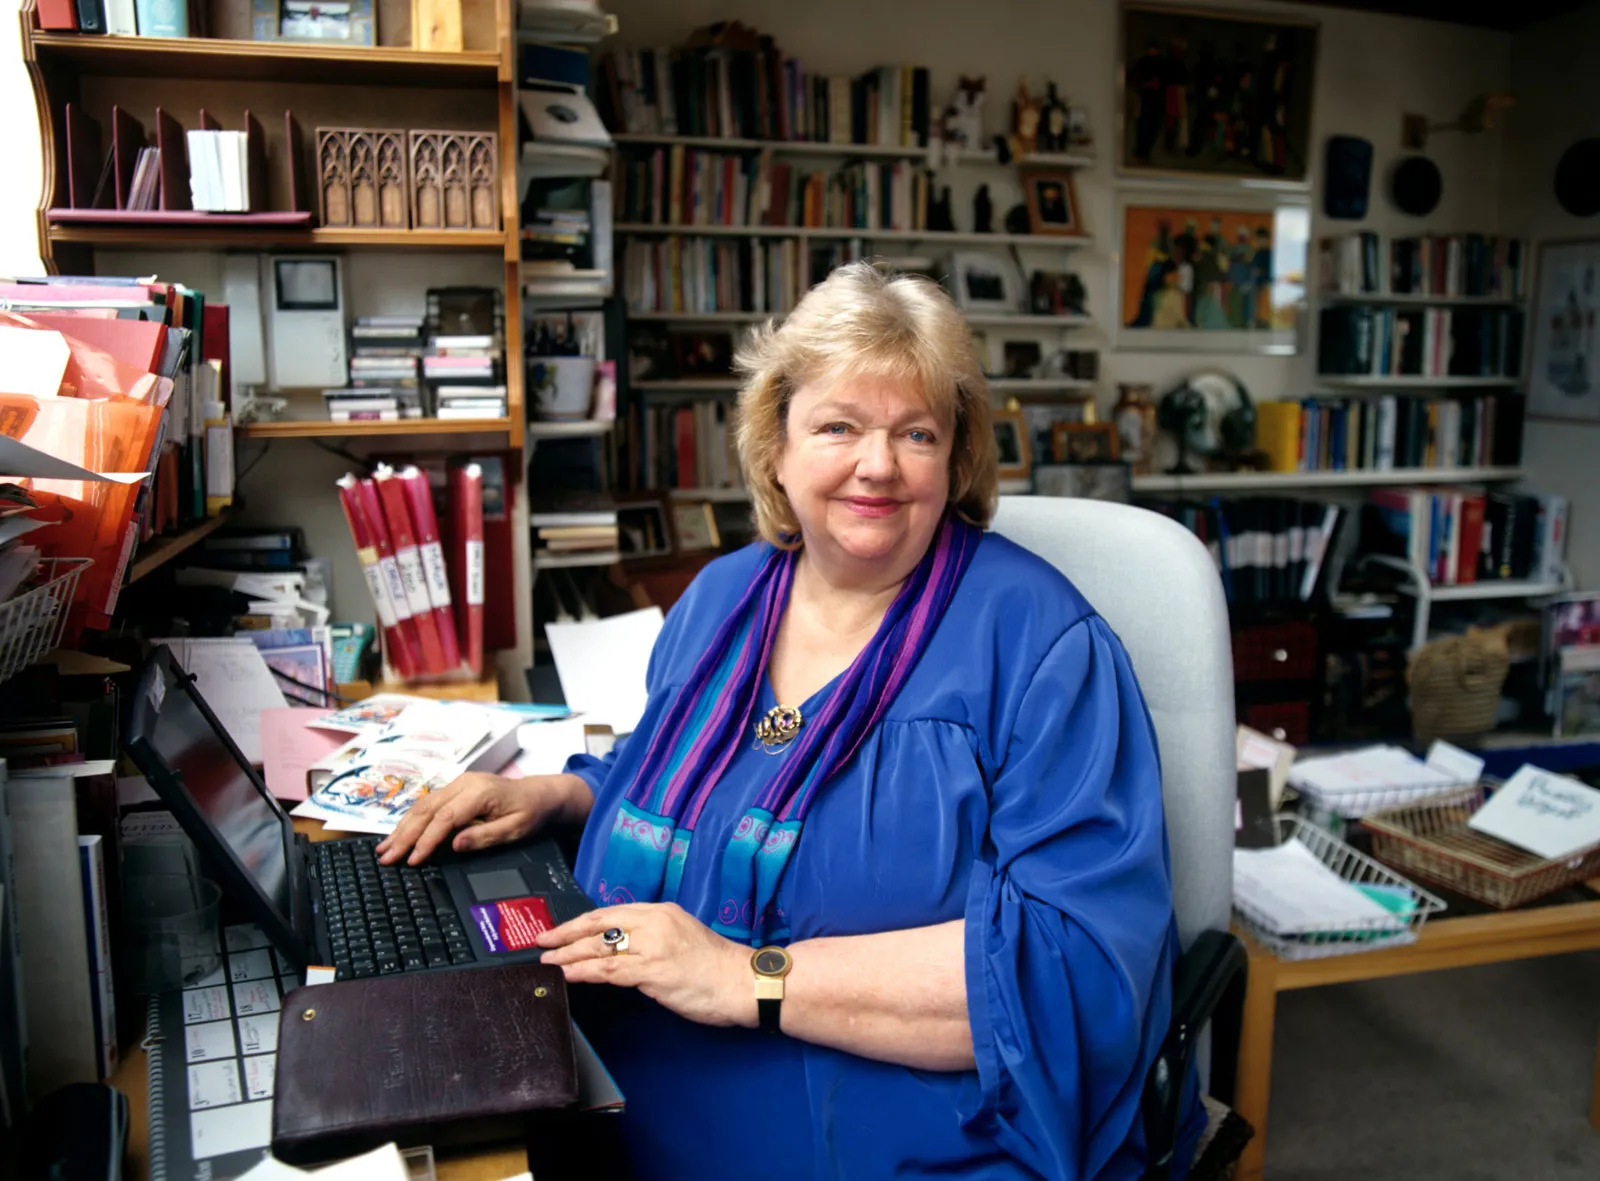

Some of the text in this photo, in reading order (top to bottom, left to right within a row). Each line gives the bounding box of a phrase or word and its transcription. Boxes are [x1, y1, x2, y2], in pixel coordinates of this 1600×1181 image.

[188, 1012, 202, 1020] 17
[246, 1042, 260, 1051] 11
[191, 1048, 206, 1058] 10
